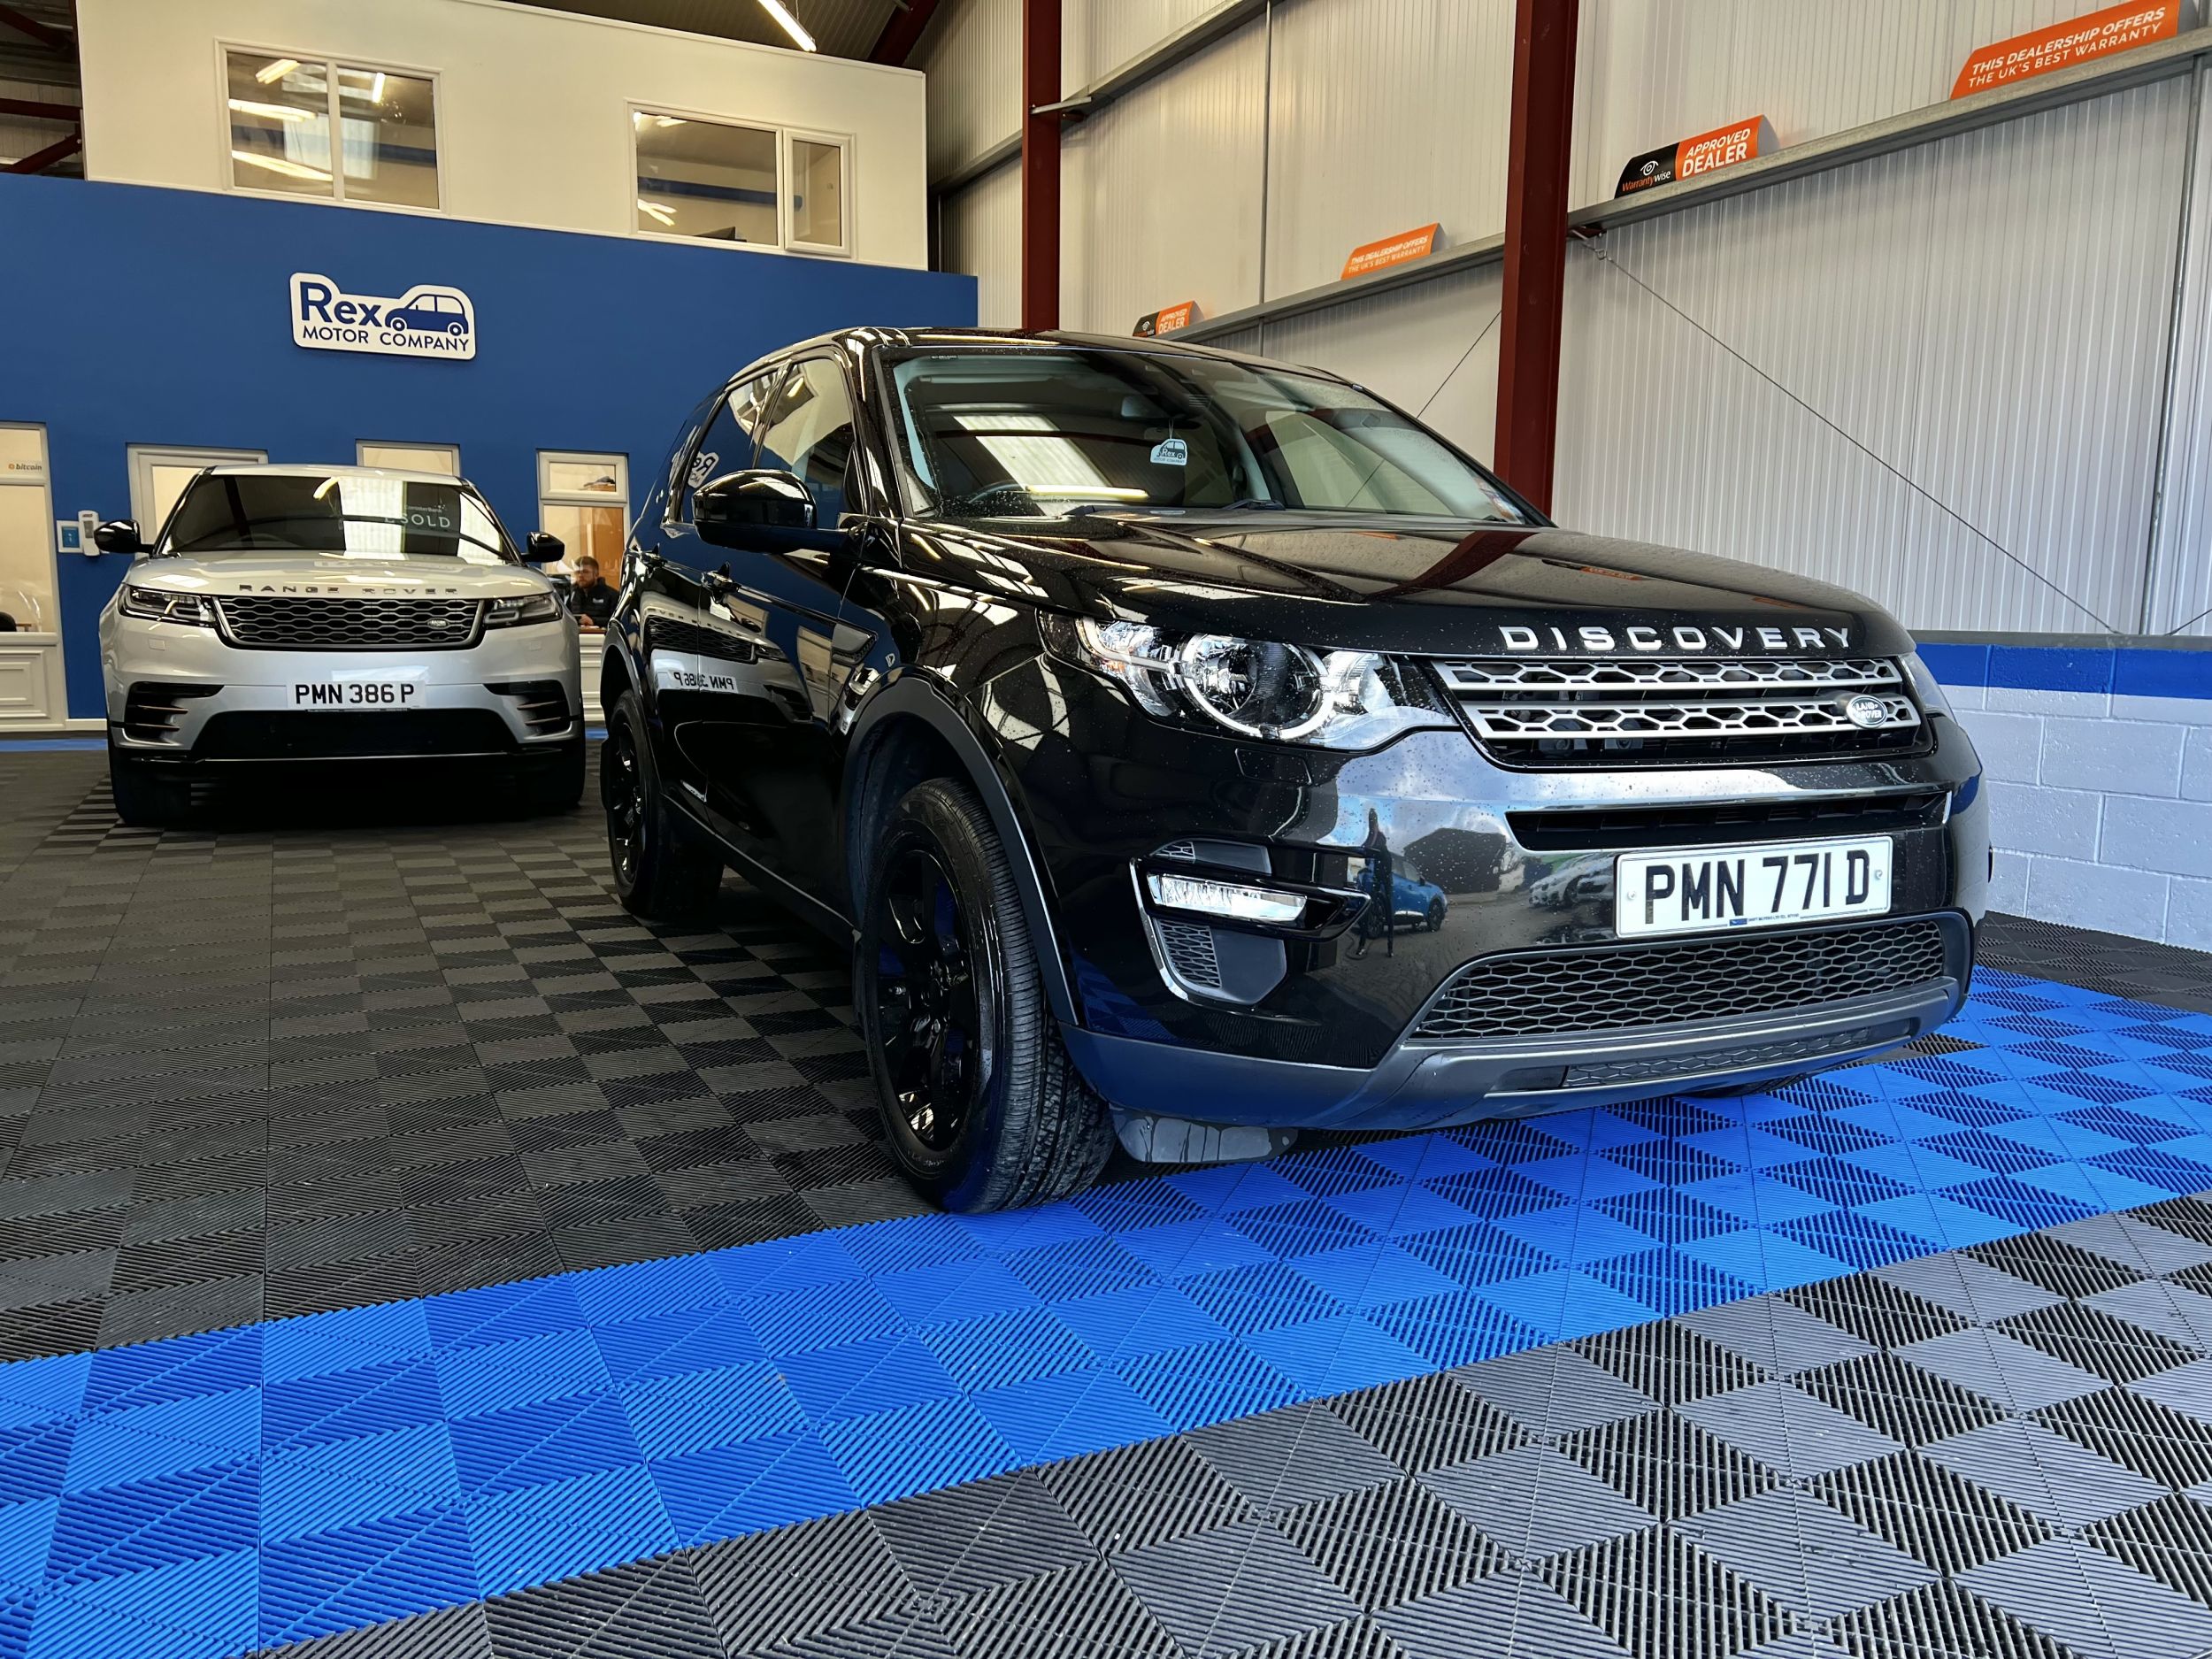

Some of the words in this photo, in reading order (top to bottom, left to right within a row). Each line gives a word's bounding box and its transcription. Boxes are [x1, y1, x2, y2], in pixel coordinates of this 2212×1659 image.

[1972, 58, 2003, 75] THIS
[2007, 29, 2101, 64] DEALERSHIP
[2102, 6, 2166, 35] OFFERS
[1969, 72, 1993, 88] THE
[1998, 62, 2030, 80] UK'S
[2034, 49, 2070, 69] BEST
[2075, 21, 2162, 56] WARRANTY
[1686, 128, 1751, 158] APPROVED
[1682, 142, 1747, 177] DEALER
[1622, 170, 1671, 192] Warrantywise
[300, 280, 382, 327] Rex
[303, 326, 369, 344] MOTOR
[380, 332, 470, 352] COMPANY
[1162, 448, 1176, 457] Rex
[16, 463, 42, 472] bitcoin
[239, 584, 340, 594] RANGE
[1498, 626, 1853, 651] DISCOVERY
[296, 684, 343, 704] PMN
[349, 683, 395, 703] 386
[401, 683, 414, 703] P
[1645, 858, 1745, 925] PMN
[1763, 852, 1832, 913] 771
[1846, 849, 1870, 906] D
